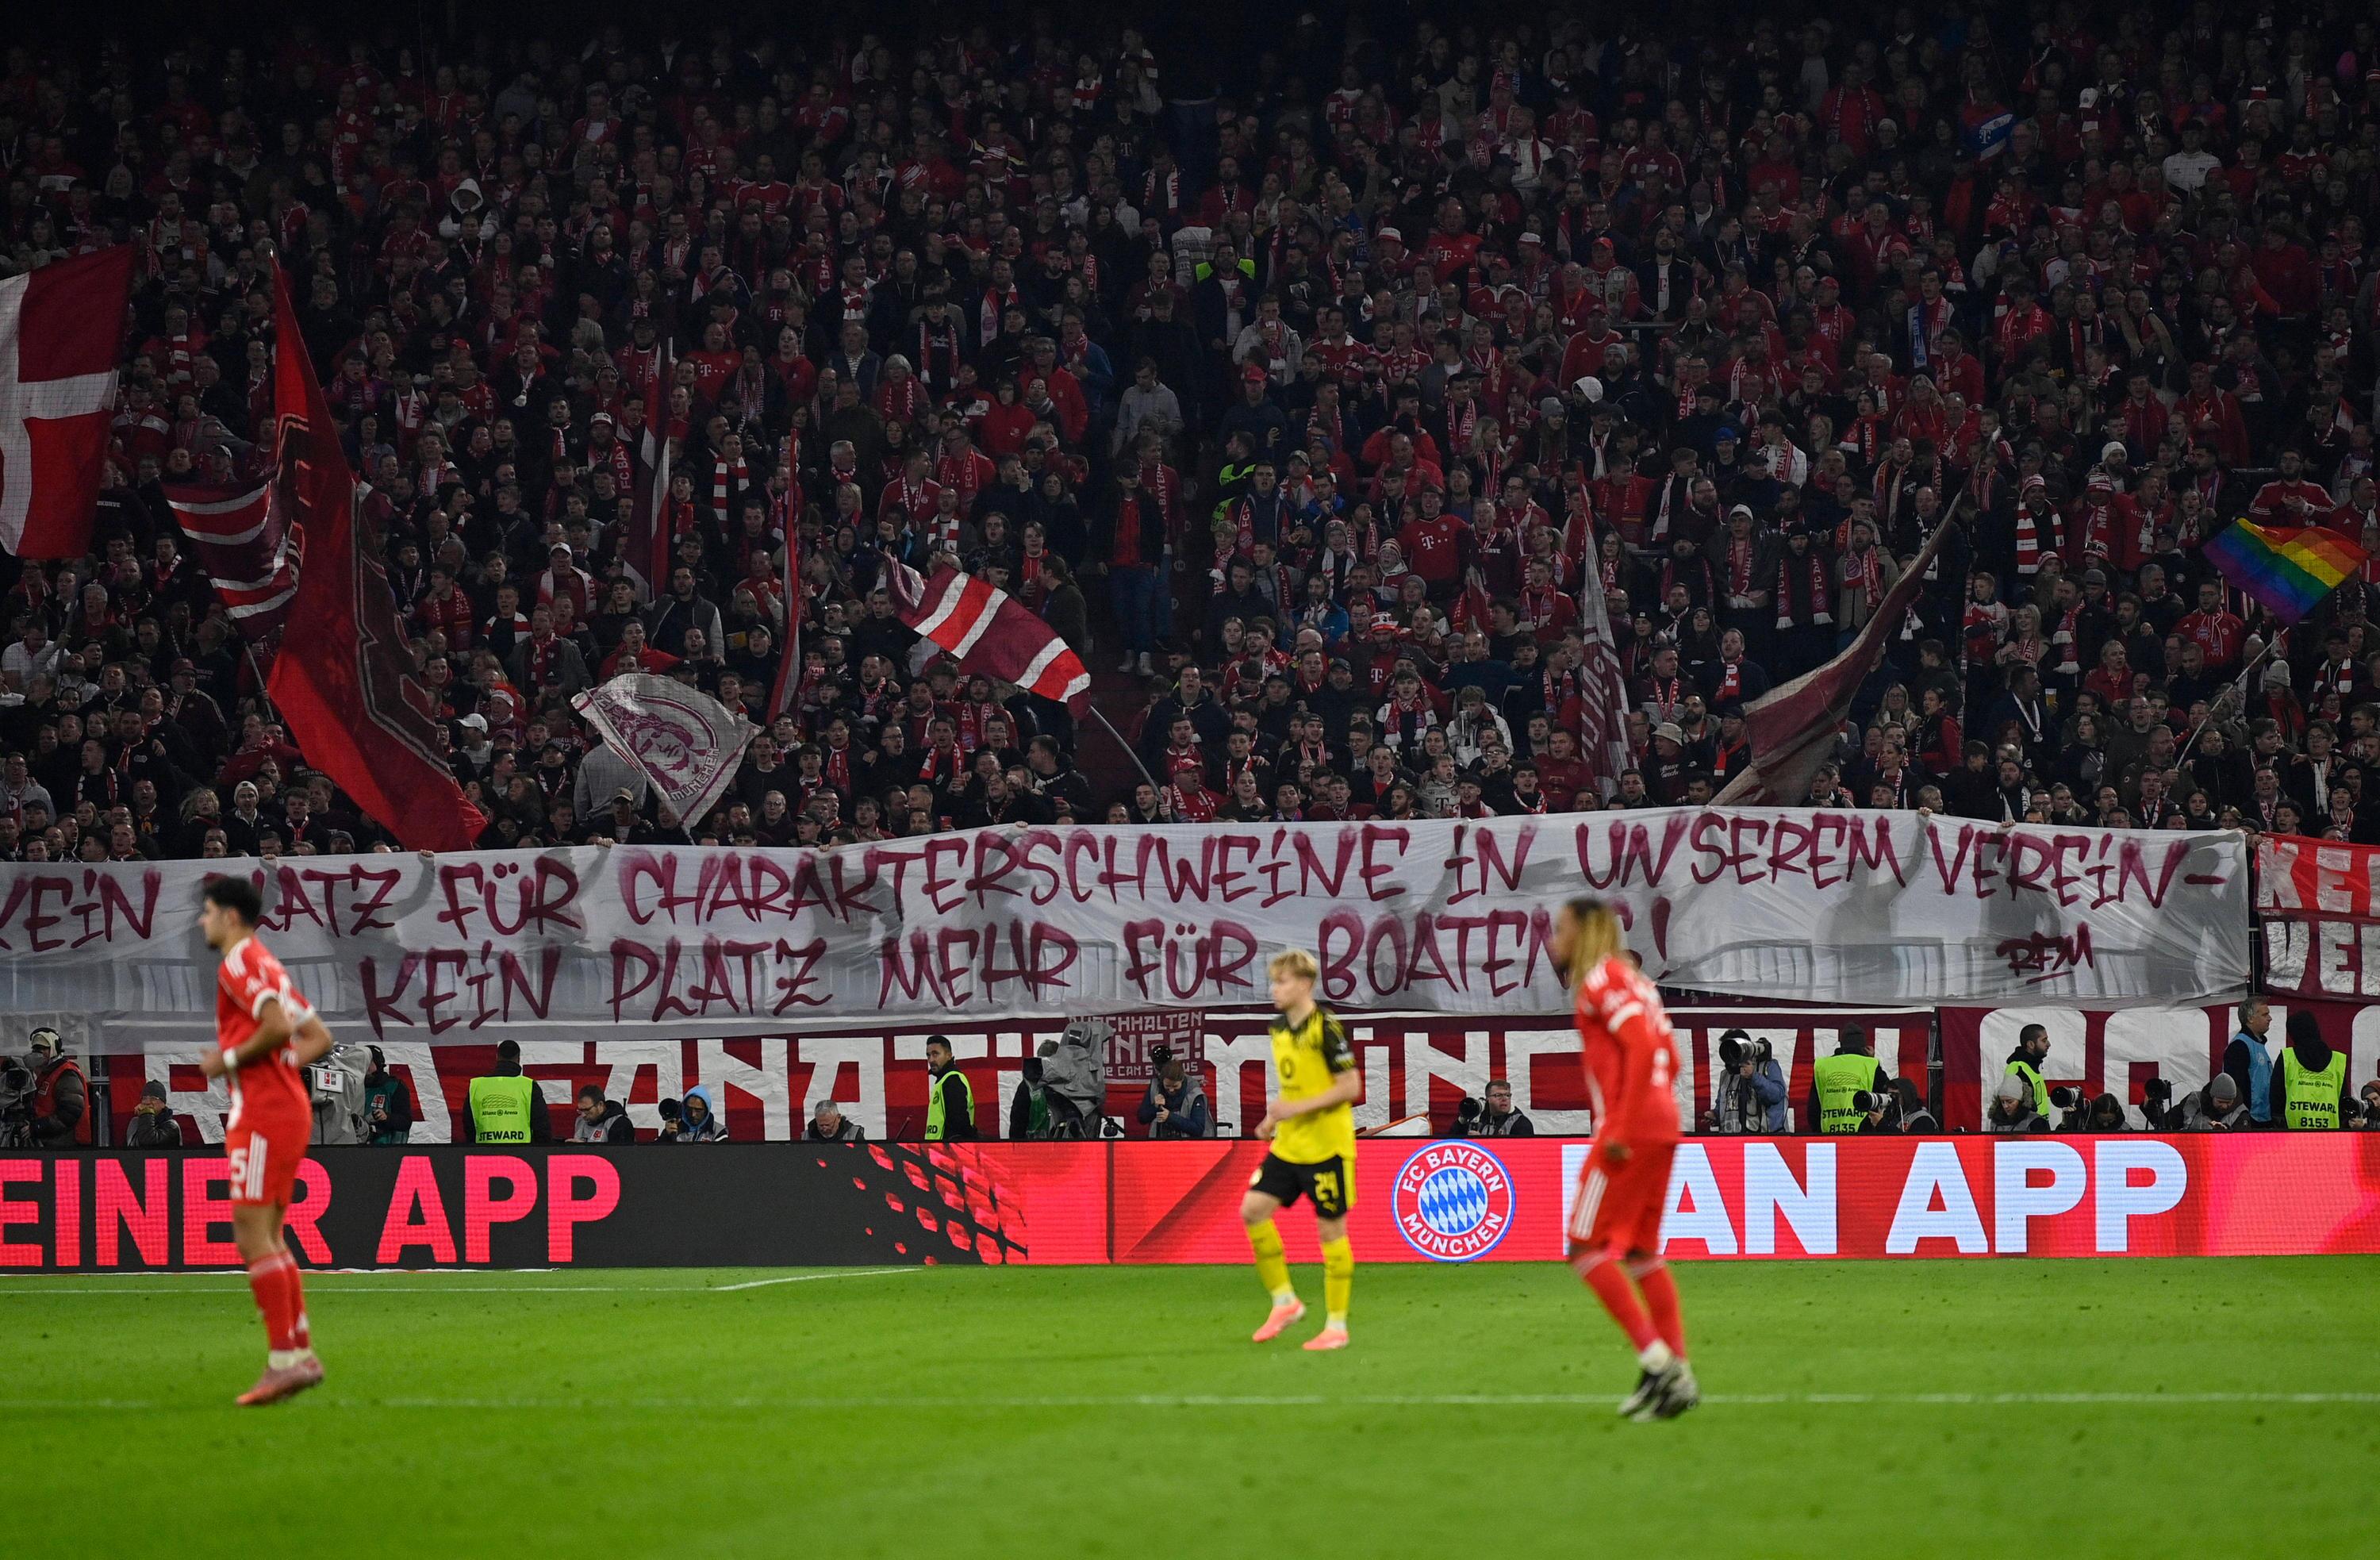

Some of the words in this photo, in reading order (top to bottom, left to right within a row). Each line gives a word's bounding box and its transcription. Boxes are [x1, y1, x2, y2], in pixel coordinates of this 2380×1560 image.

[203, 863, 401, 938] LATZ
[438, 856, 582, 939] FÜR
[619, 823, 1411, 925] CHARAKTERSCHWEINE
[1444, 821, 1540, 905] IN
[359, 939, 562, 1040] KEIN
[607, 937, 833, 1023] PLATZ
[877, 919, 1079, 1009] MEHR
[1124, 916, 1259, 1000] FÜR
[478, 1130, 524, 1141] STEWARD
[1829, 1123, 1856, 1133] 8135
[2300, 1116, 2329, 1128] 8153
[1402, 1164, 1426, 1193] FC
[1425, 1148, 1504, 1193] BAYERN
[1885, 1139, 2188, 1255] APP
[376, 1155, 621, 1263] APP
